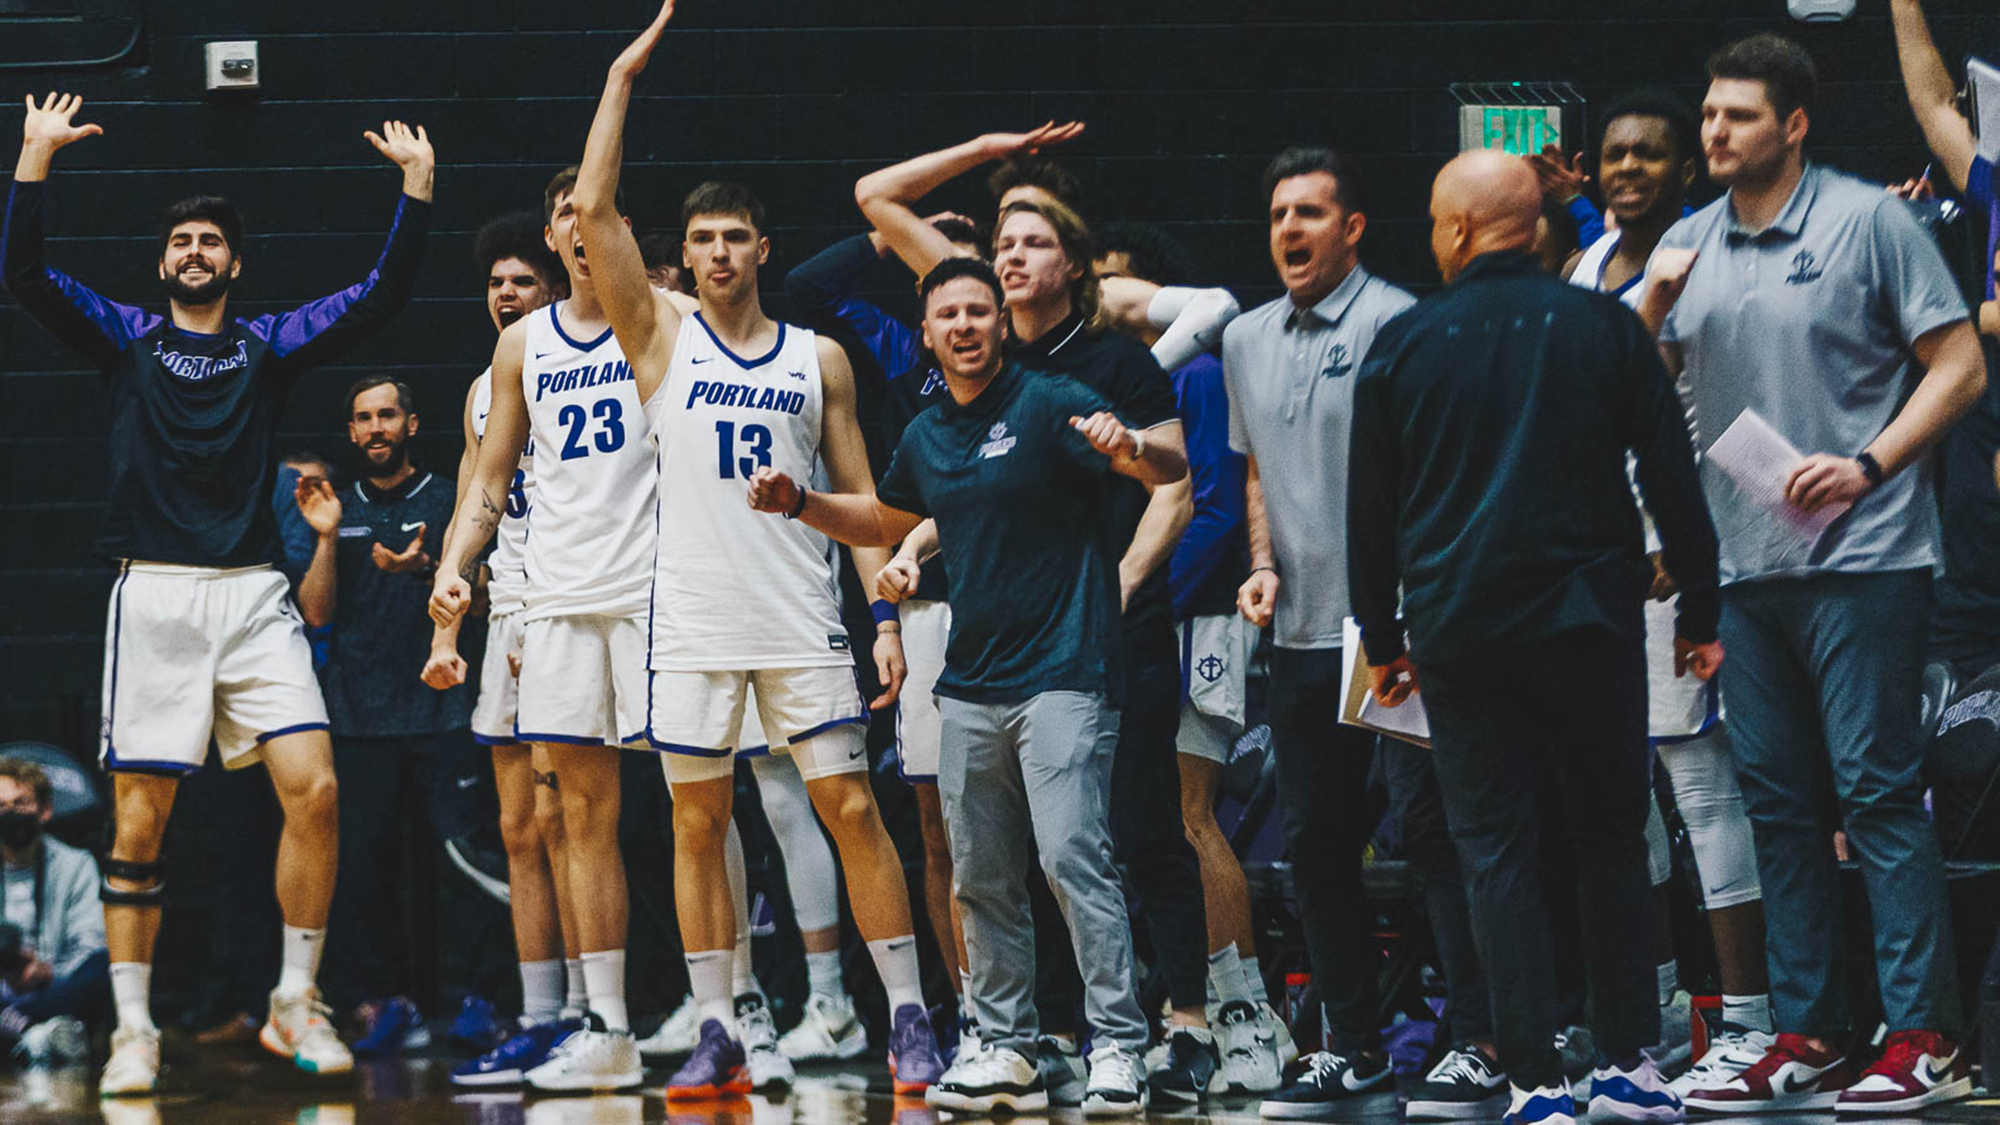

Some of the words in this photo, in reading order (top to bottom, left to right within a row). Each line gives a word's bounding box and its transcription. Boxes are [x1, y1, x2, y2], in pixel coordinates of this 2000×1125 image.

[1482, 107, 1547, 156] EXIT
[685, 380, 806, 416] PORTLAND
[558, 398, 625, 461] 23
[715, 420, 772, 481] 13
